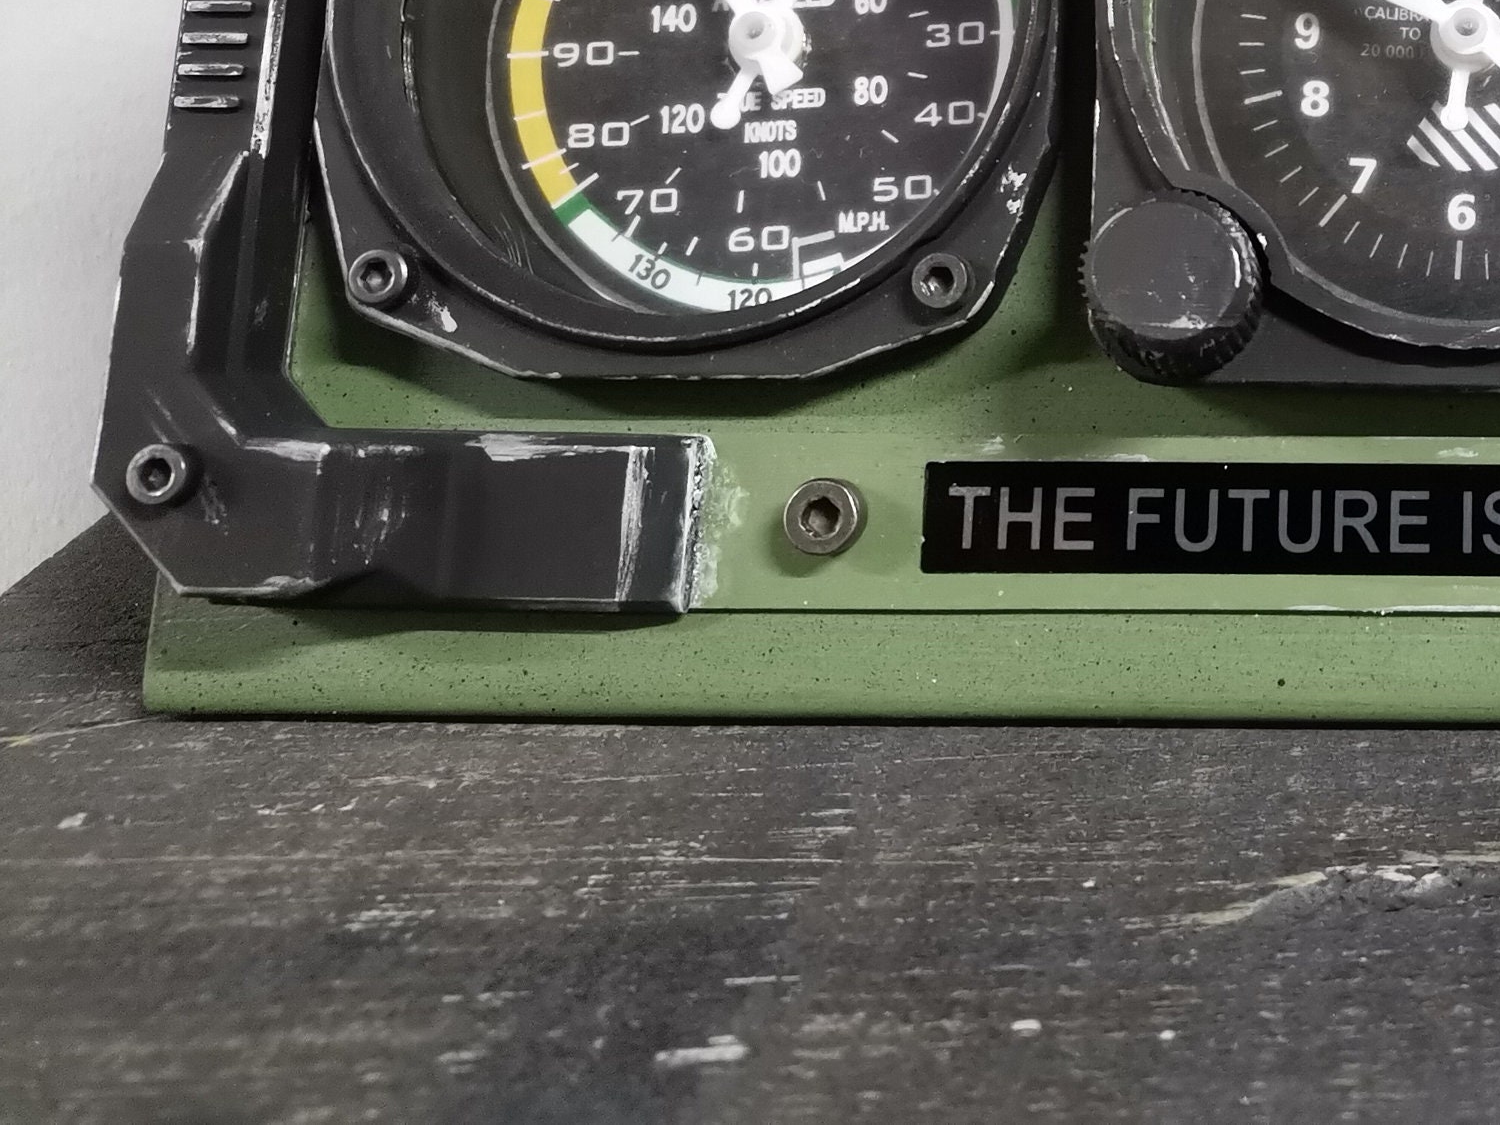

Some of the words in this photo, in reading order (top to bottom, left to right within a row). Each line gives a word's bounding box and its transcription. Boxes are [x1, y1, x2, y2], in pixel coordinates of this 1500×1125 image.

[650, 2, 698, 34] 140
[1294, 12, 1321, 50] 9
[925, 20, 985, 49] 30
[1399, 26, 1422, 41] TO
[553, 41, 615, 68] 90
[1360, 43, 1381, 58] 20
[771, 87, 826, 111] SPEED
[854, 74, 889, 106] 80
[1300, 79, 1331, 117] 8
[660, 102, 706, 135] 120
[913, 100, 976, 127] 40
[567, 121, 630, 149] 80
[743, 119, 798, 144] KNOTS
[758, 147, 802, 179] 100
[1348, 156, 1378, 194] 7
[616, 187, 679, 215] 70
[872, 174, 933, 203] 50
[1447, 192, 1478, 232] 6
[728, 224, 791, 253] 60
[627, 252, 673, 291] 130
[727, 287, 774, 312] 120
[948, 484, 1096, 551] THE
[1126, 487, 1431, 554] FUTURE
